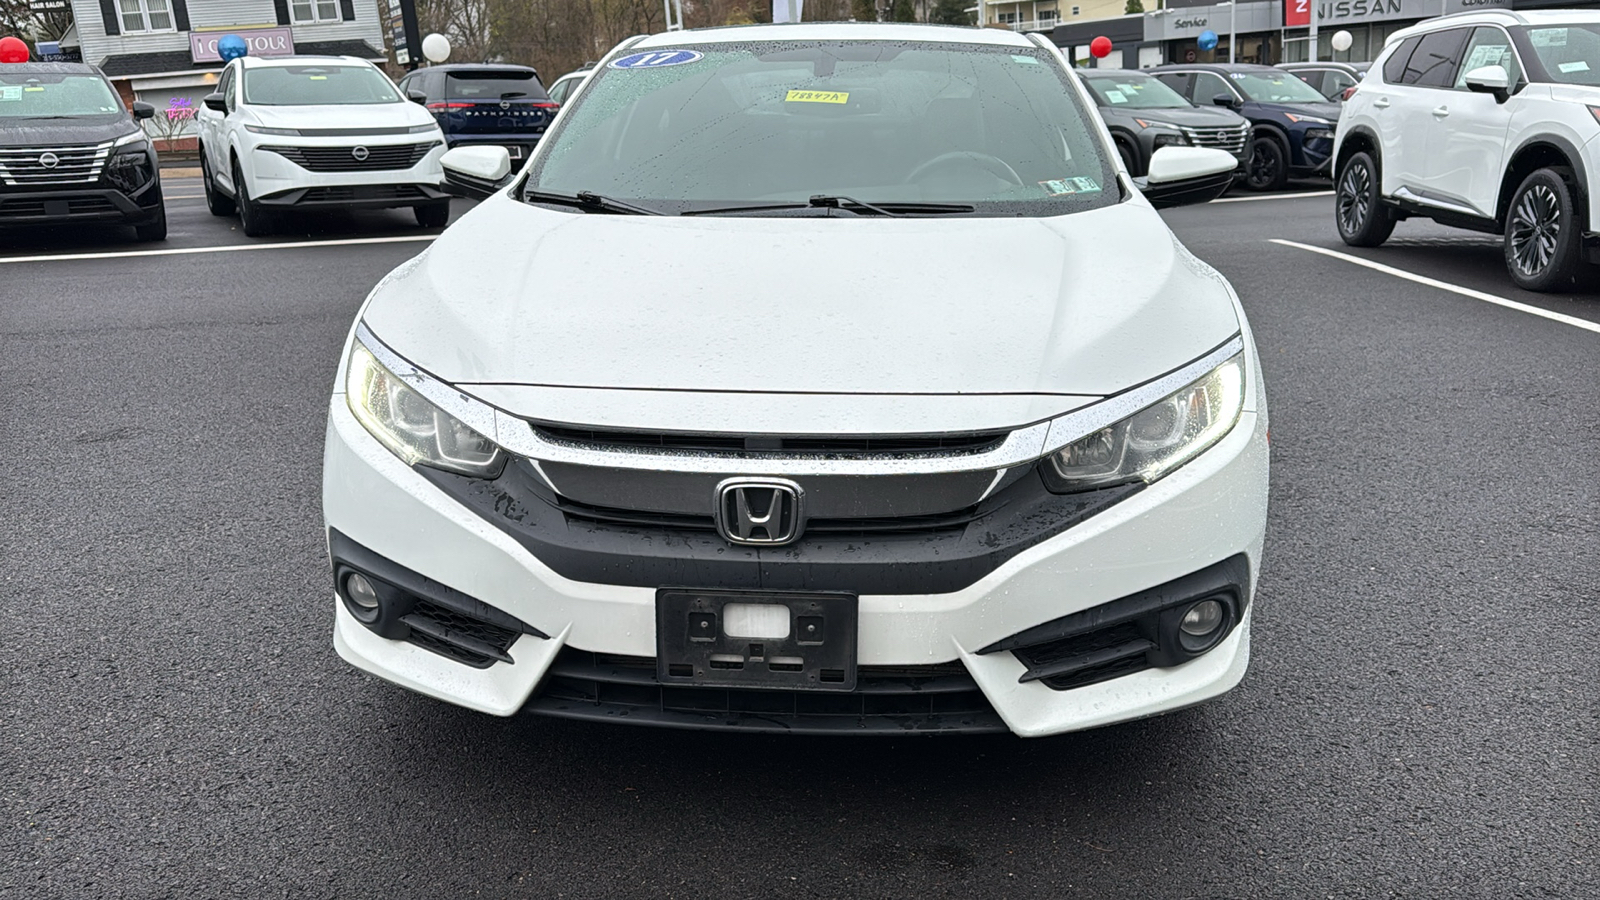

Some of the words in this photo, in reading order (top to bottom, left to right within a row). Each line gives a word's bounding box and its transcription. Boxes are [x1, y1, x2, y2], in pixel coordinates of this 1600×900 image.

[45, 1, 66, 9] SALON
[1174, 17, 1208, 29] Service
[630, 52, 680, 67] 17
[791, 92, 839, 101] 78847A
